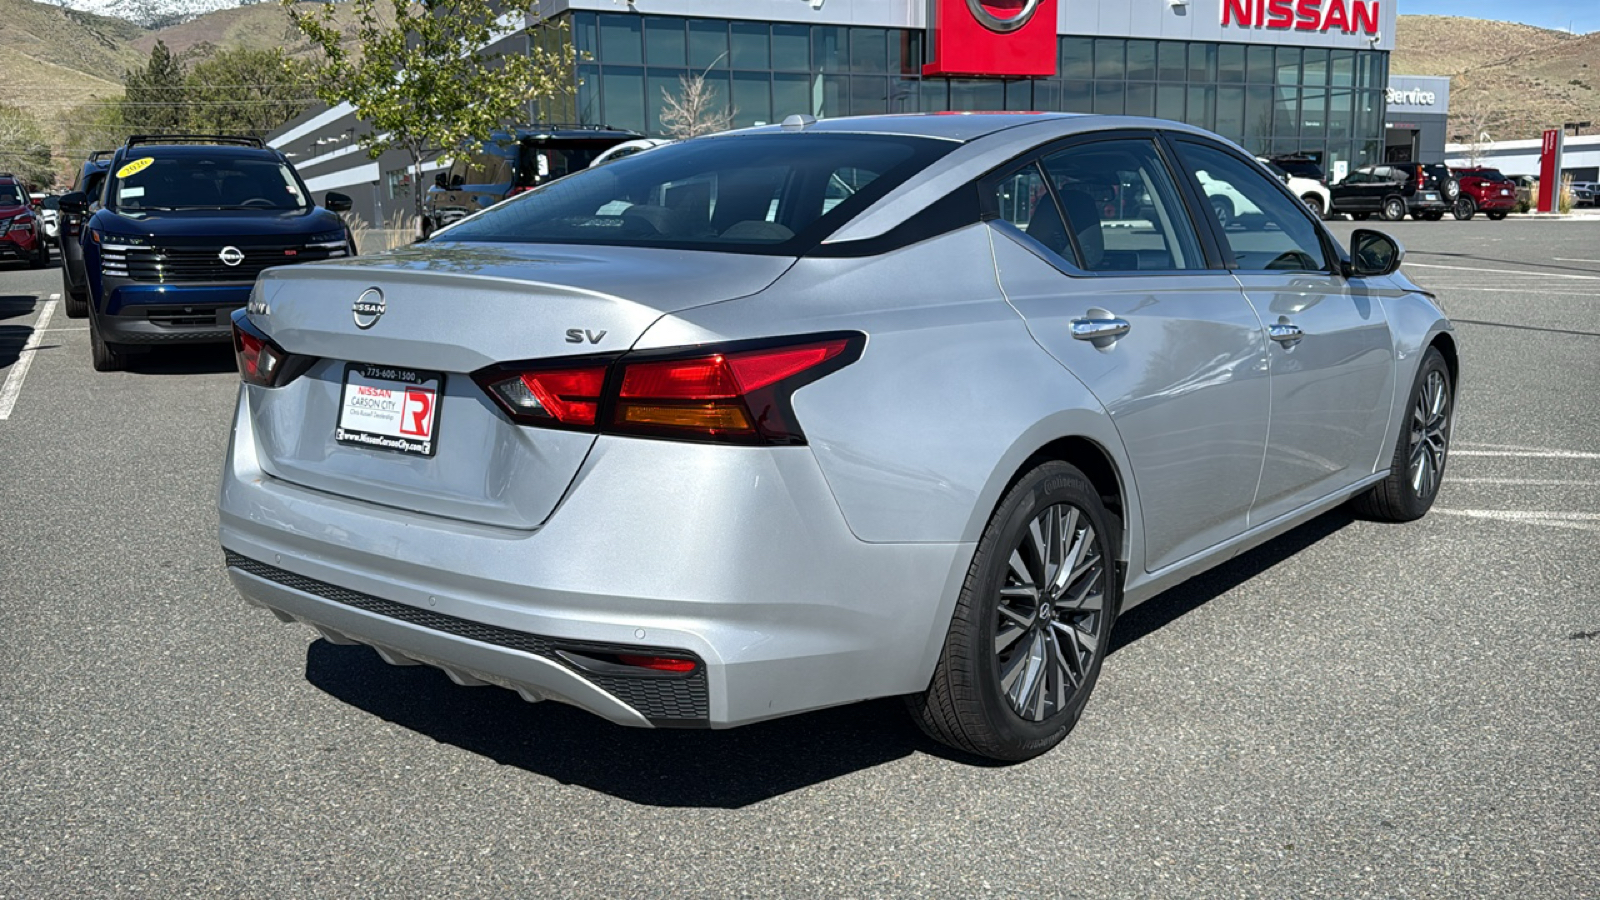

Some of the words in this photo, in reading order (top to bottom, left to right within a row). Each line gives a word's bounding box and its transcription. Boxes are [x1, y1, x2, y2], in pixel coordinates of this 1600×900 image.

[1221, 0, 1380, 33] NISSAN
[1385, 87, 1435, 105] Service
[565, 329, 607, 344] SV
[367, 367, 416, 381] 775-600-1500
[358, 386, 392, 399] NISSAN
[350, 396, 380, 408] CARSON
[381, 400, 396, 410] CITY
